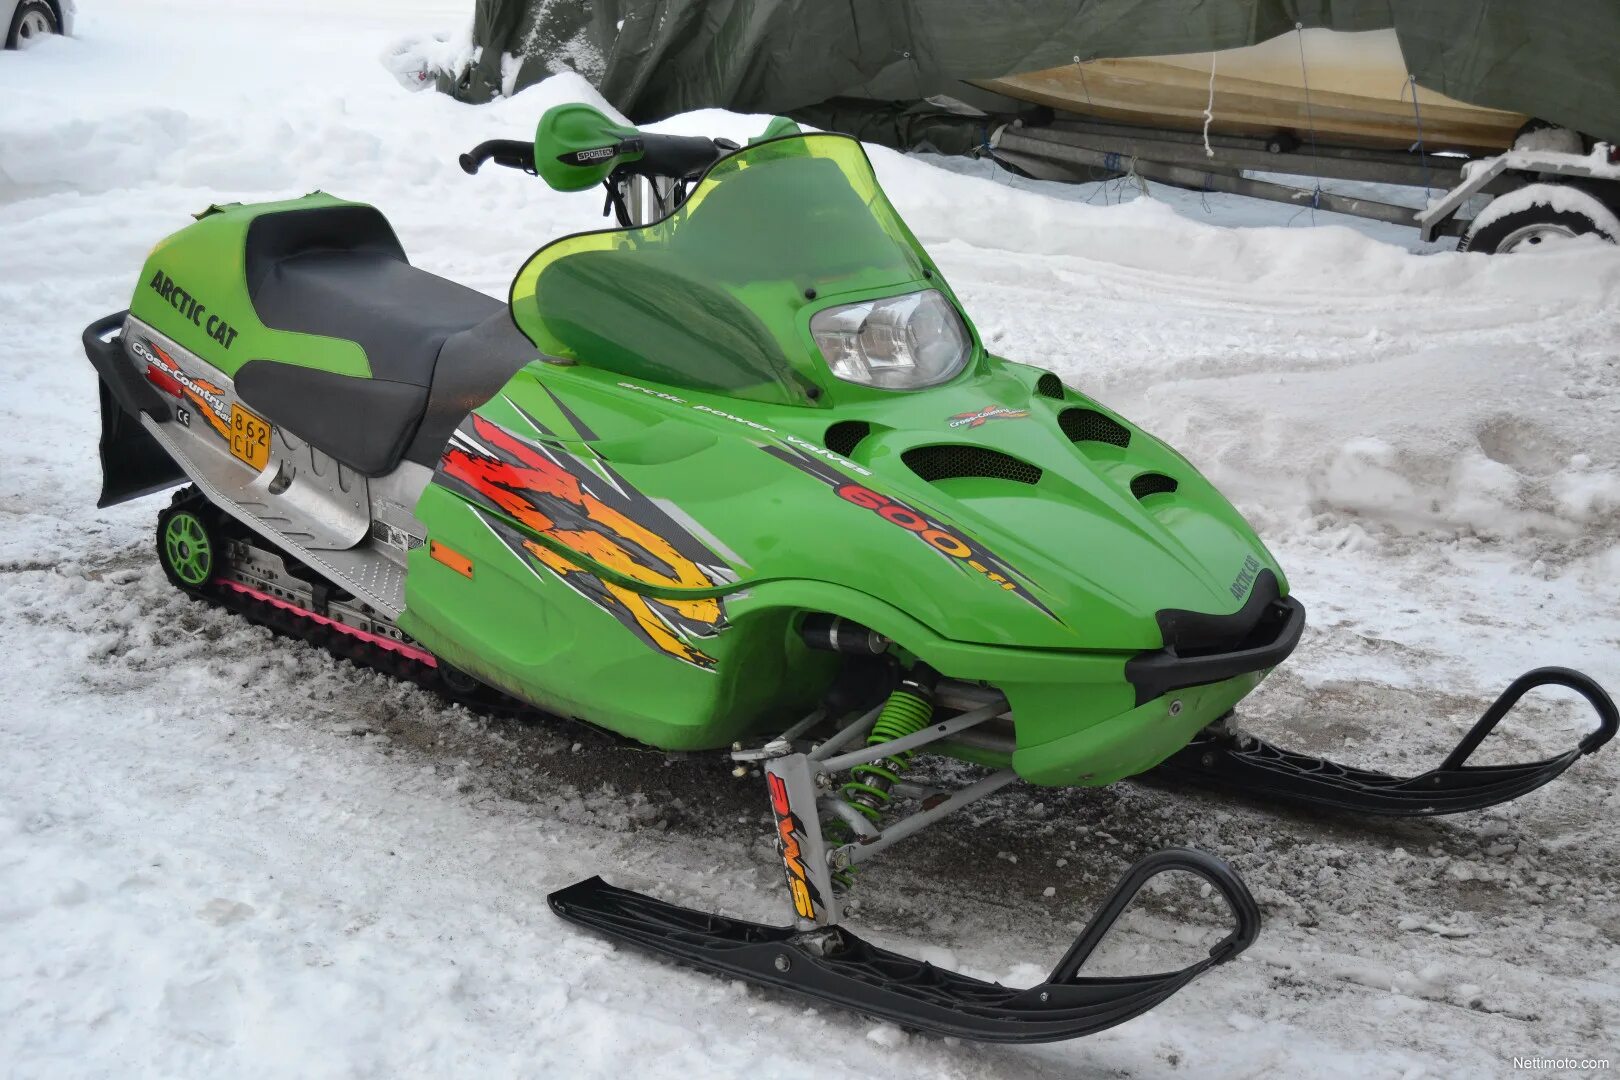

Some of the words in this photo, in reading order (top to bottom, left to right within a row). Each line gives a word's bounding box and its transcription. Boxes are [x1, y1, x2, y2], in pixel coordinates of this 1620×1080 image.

[577, 148, 614, 160] SPORTECH
[150, 269, 206, 327] ARCTIC
[205, 314, 239, 350] CAT
[132, 342, 225, 412] Cross-Country
[234, 413, 266, 447] 862
[234, 434, 255, 460] CU
[617, 382, 687, 404] arctic
[692, 405, 776, 433] power
[787, 435, 872, 476] valves
[837, 484, 972, 559] 600
[1230, 568, 1254, 600] ARCTIC
[1244, 555, 1260, 573] CAT
